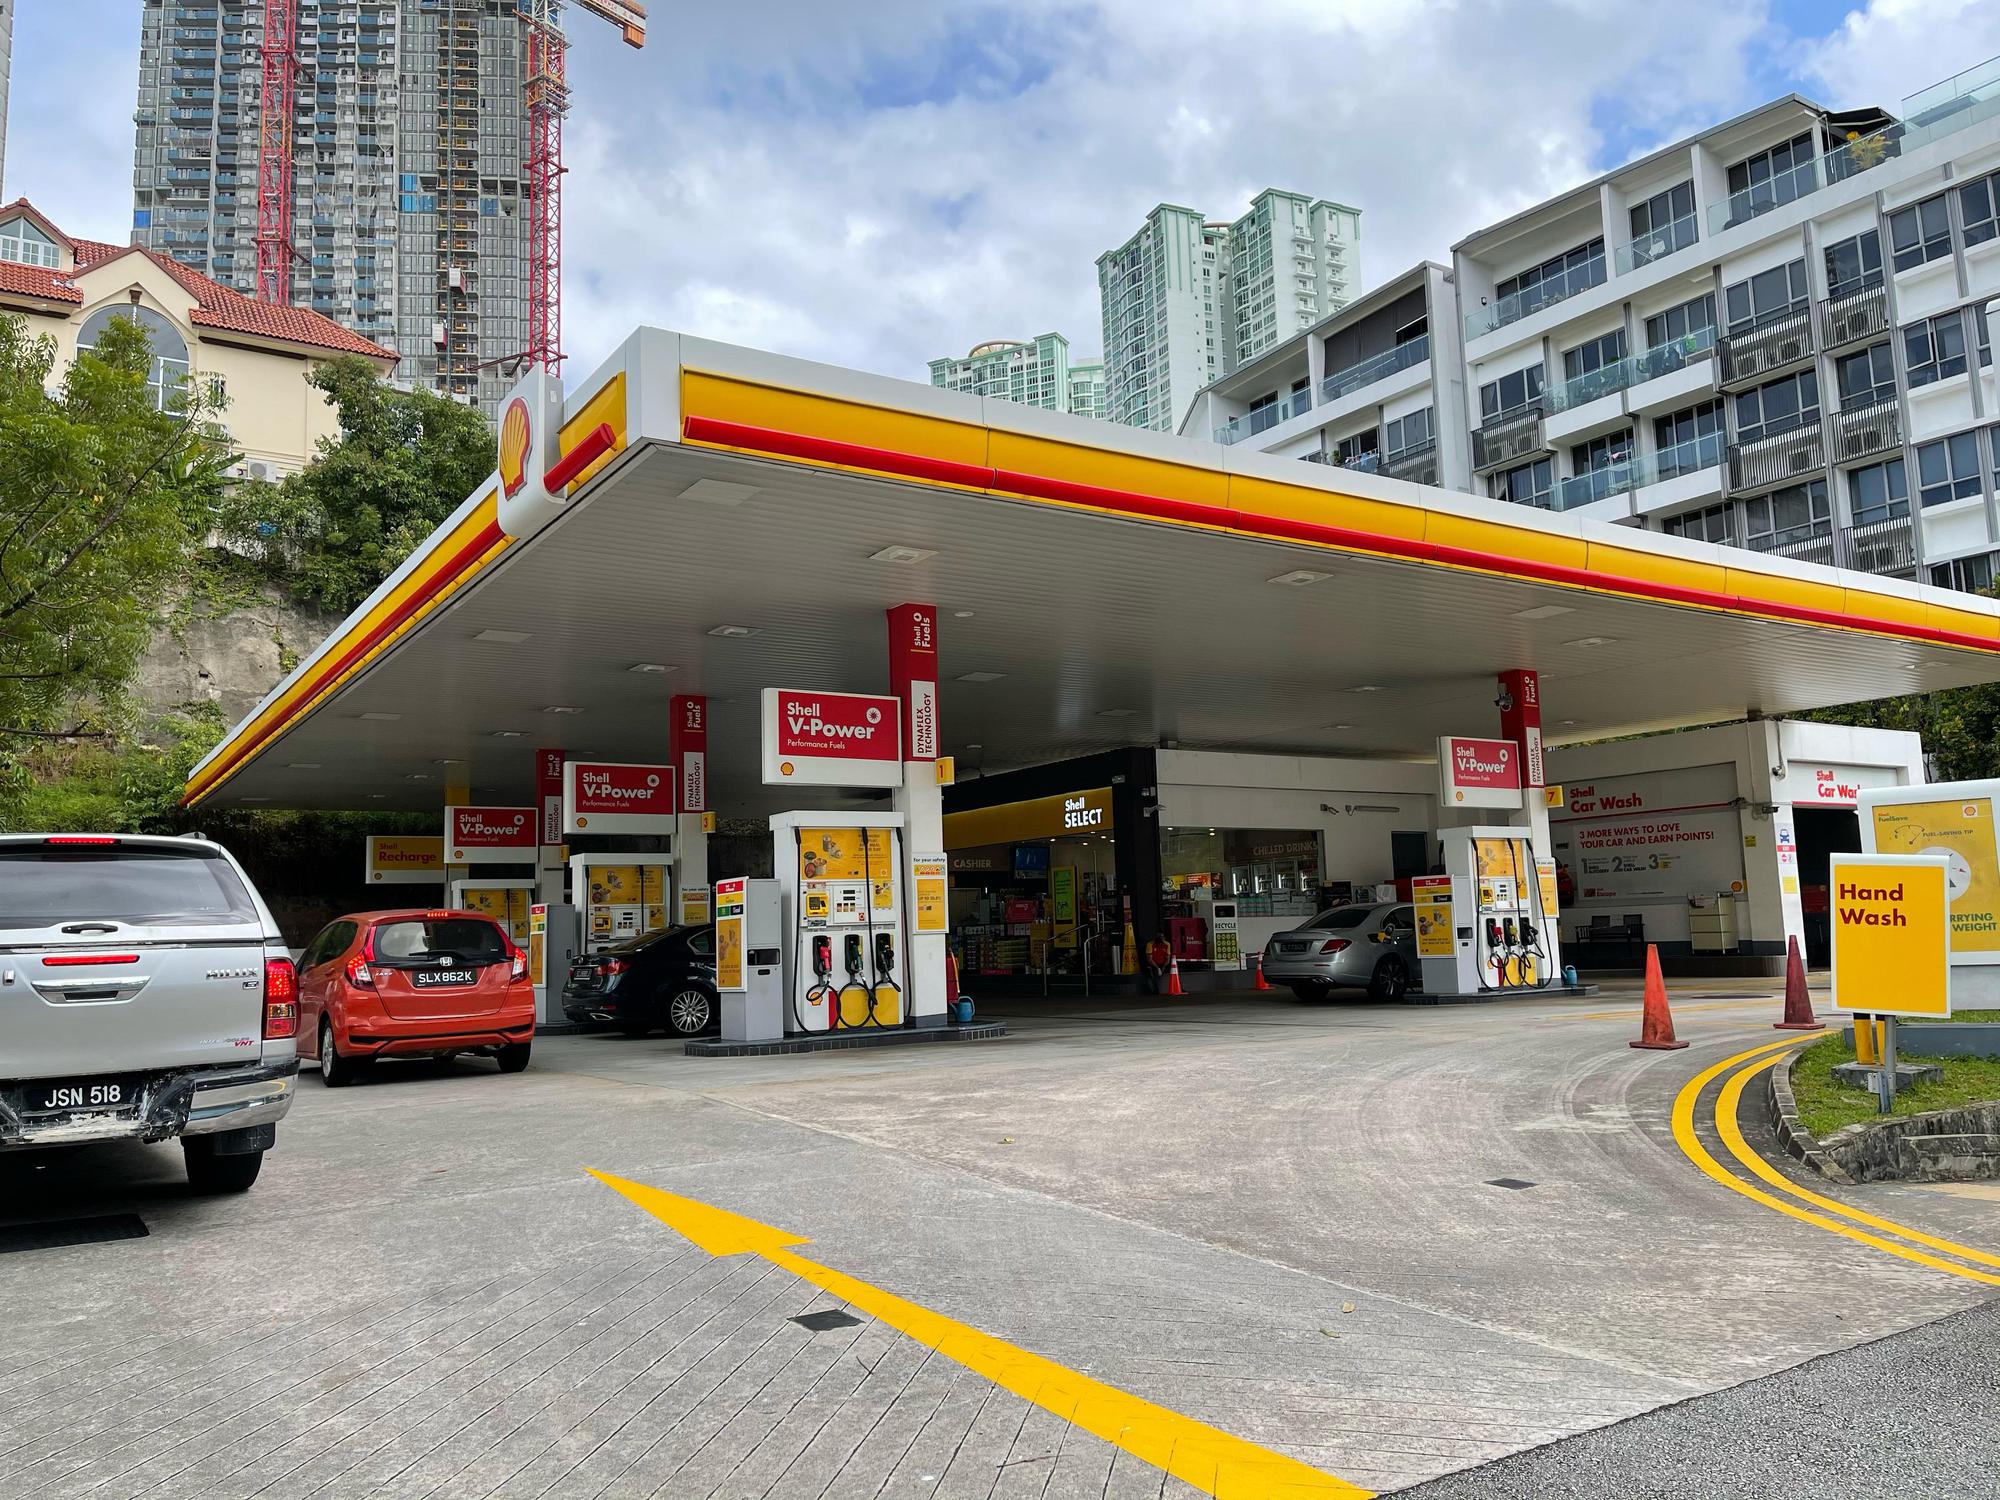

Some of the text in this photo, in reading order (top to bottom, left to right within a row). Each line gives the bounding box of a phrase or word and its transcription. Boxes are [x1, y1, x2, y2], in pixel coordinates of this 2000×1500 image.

[921, 617, 931, 648] Fuels
[693, 705, 701, 728] Fuels
[787, 702, 820, 717] Shell
[787, 717, 875, 739] V-Power
[787, 739, 846, 750] Performance Fuels
[1456, 746, 1475, 757] Shell
[1457, 758, 1505, 774] V-Power
[1529, 748, 1537, 782] DYNAFLEX
[1534, 736, 1542, 782] TECHNOLOGY
[582, 772, 610, 783] Shell
[939, 764, 944, 779] 1
[1816, 770, 1834, 781] Shell
[583, 783, 654, 799] V-Power
[1547, 791, 1555, 802] 7
[1569, 786, 1595, 798] Shell
[1818, 784, 1835, 798] Car
[582, 800, 630, 808] Performance Fuels
[1064, 797, 1085, 812] Shell
[1570, 793, 1642, 813] Car Wash
[459, 814, 482, 823] Shell
[1064, 808, 1103, 829] SELECT
[459, 823, 520, 835] V-Power
[1579, 823, 1680, 839] 3 MORE WAYS TO LOVE
[1580, 831, 1714, 849] YOUR CAR AND EARN POINTS!
[379, 851, 437, 864] Recharge
[1253, 844, 1284, 856] CHILLED
[953, 857, 992, 869] CASHIER
[1612, 856, 1623, 873] 2
[1648, 853, 1659, 869] 3
[1839, 883, 1904, 901] Hand
[1839, 908, 1907, 926] Wash
[1950, 912, 1993, 922] RRYING
[1952, 922, 1997, 932] WEIGHT
[206, 968, 258, 979] HILUX
[418, 971, 472, 983] SLX862K
[45, 1084, 121, 1108] JSN 518
